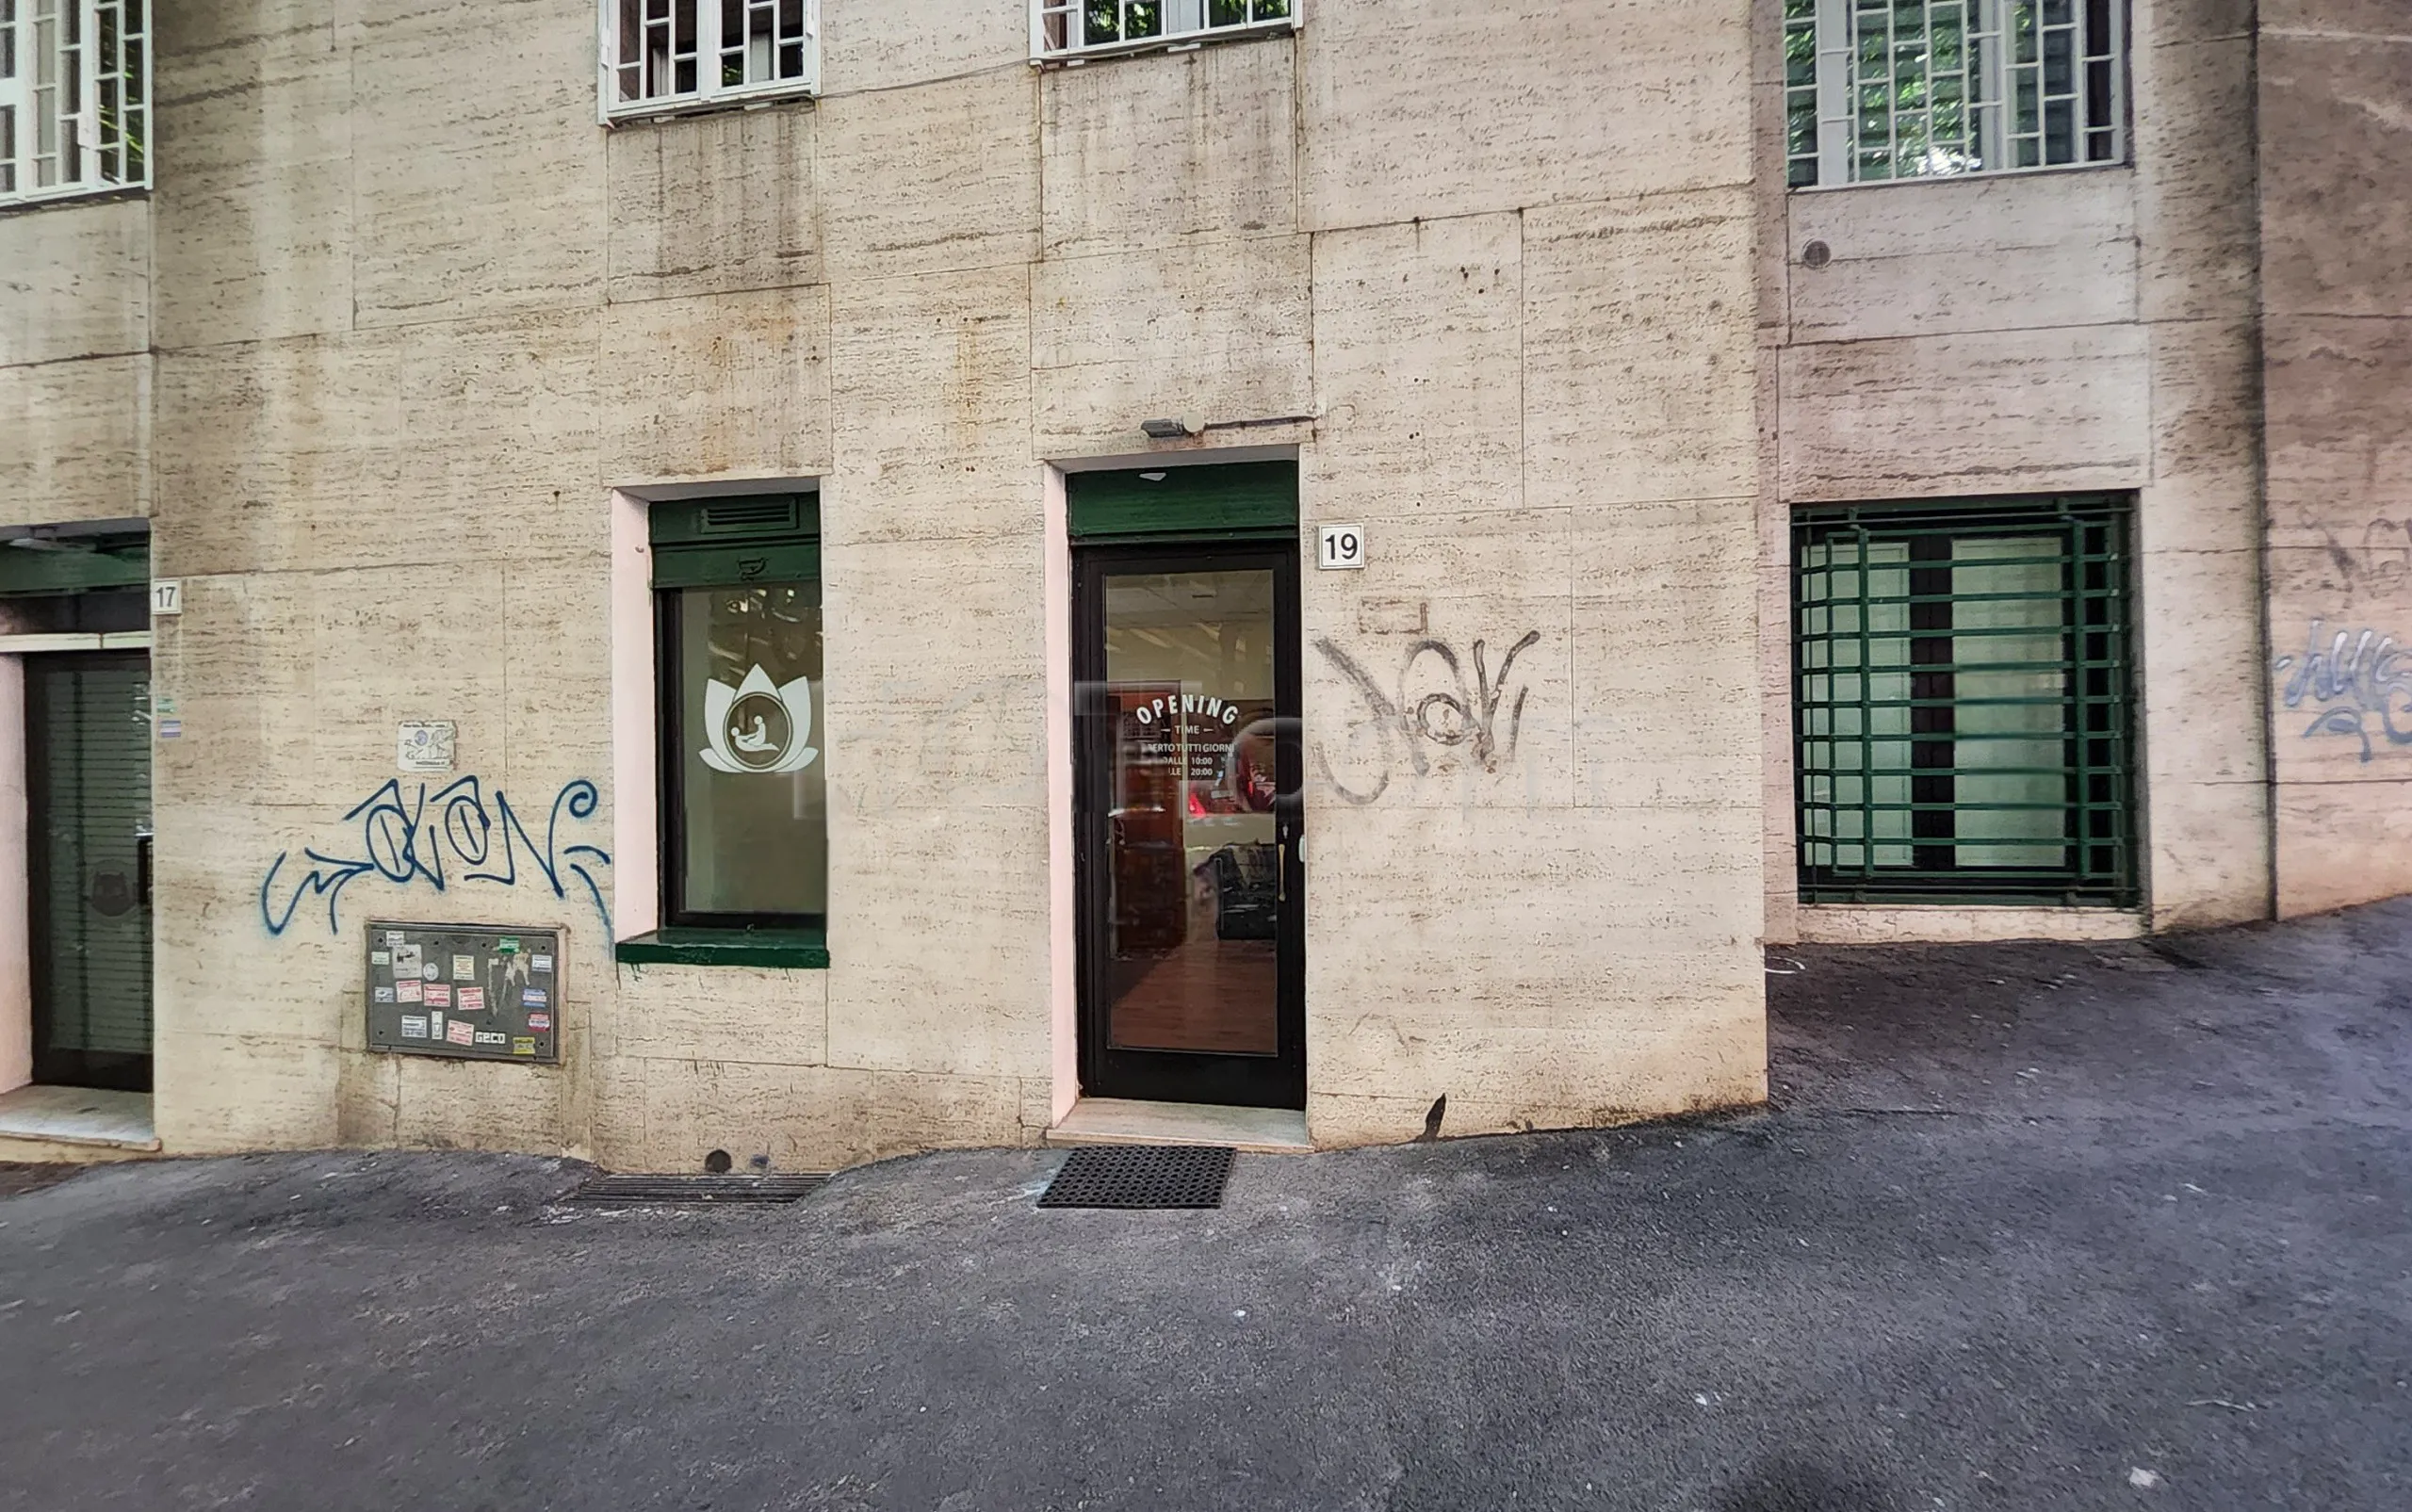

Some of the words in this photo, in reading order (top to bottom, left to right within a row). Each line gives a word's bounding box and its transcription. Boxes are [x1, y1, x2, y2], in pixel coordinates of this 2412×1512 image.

[1325, 533, 1358, 561] 19
[156, 586, 176, 608] 17
[1136, 694, 1238, 724] OPENING
[1174, 724, 1200, 735] TIME
[1191, 756, 1214, 766] 10:00
[1190, 767, 1214, 776] 20:00
